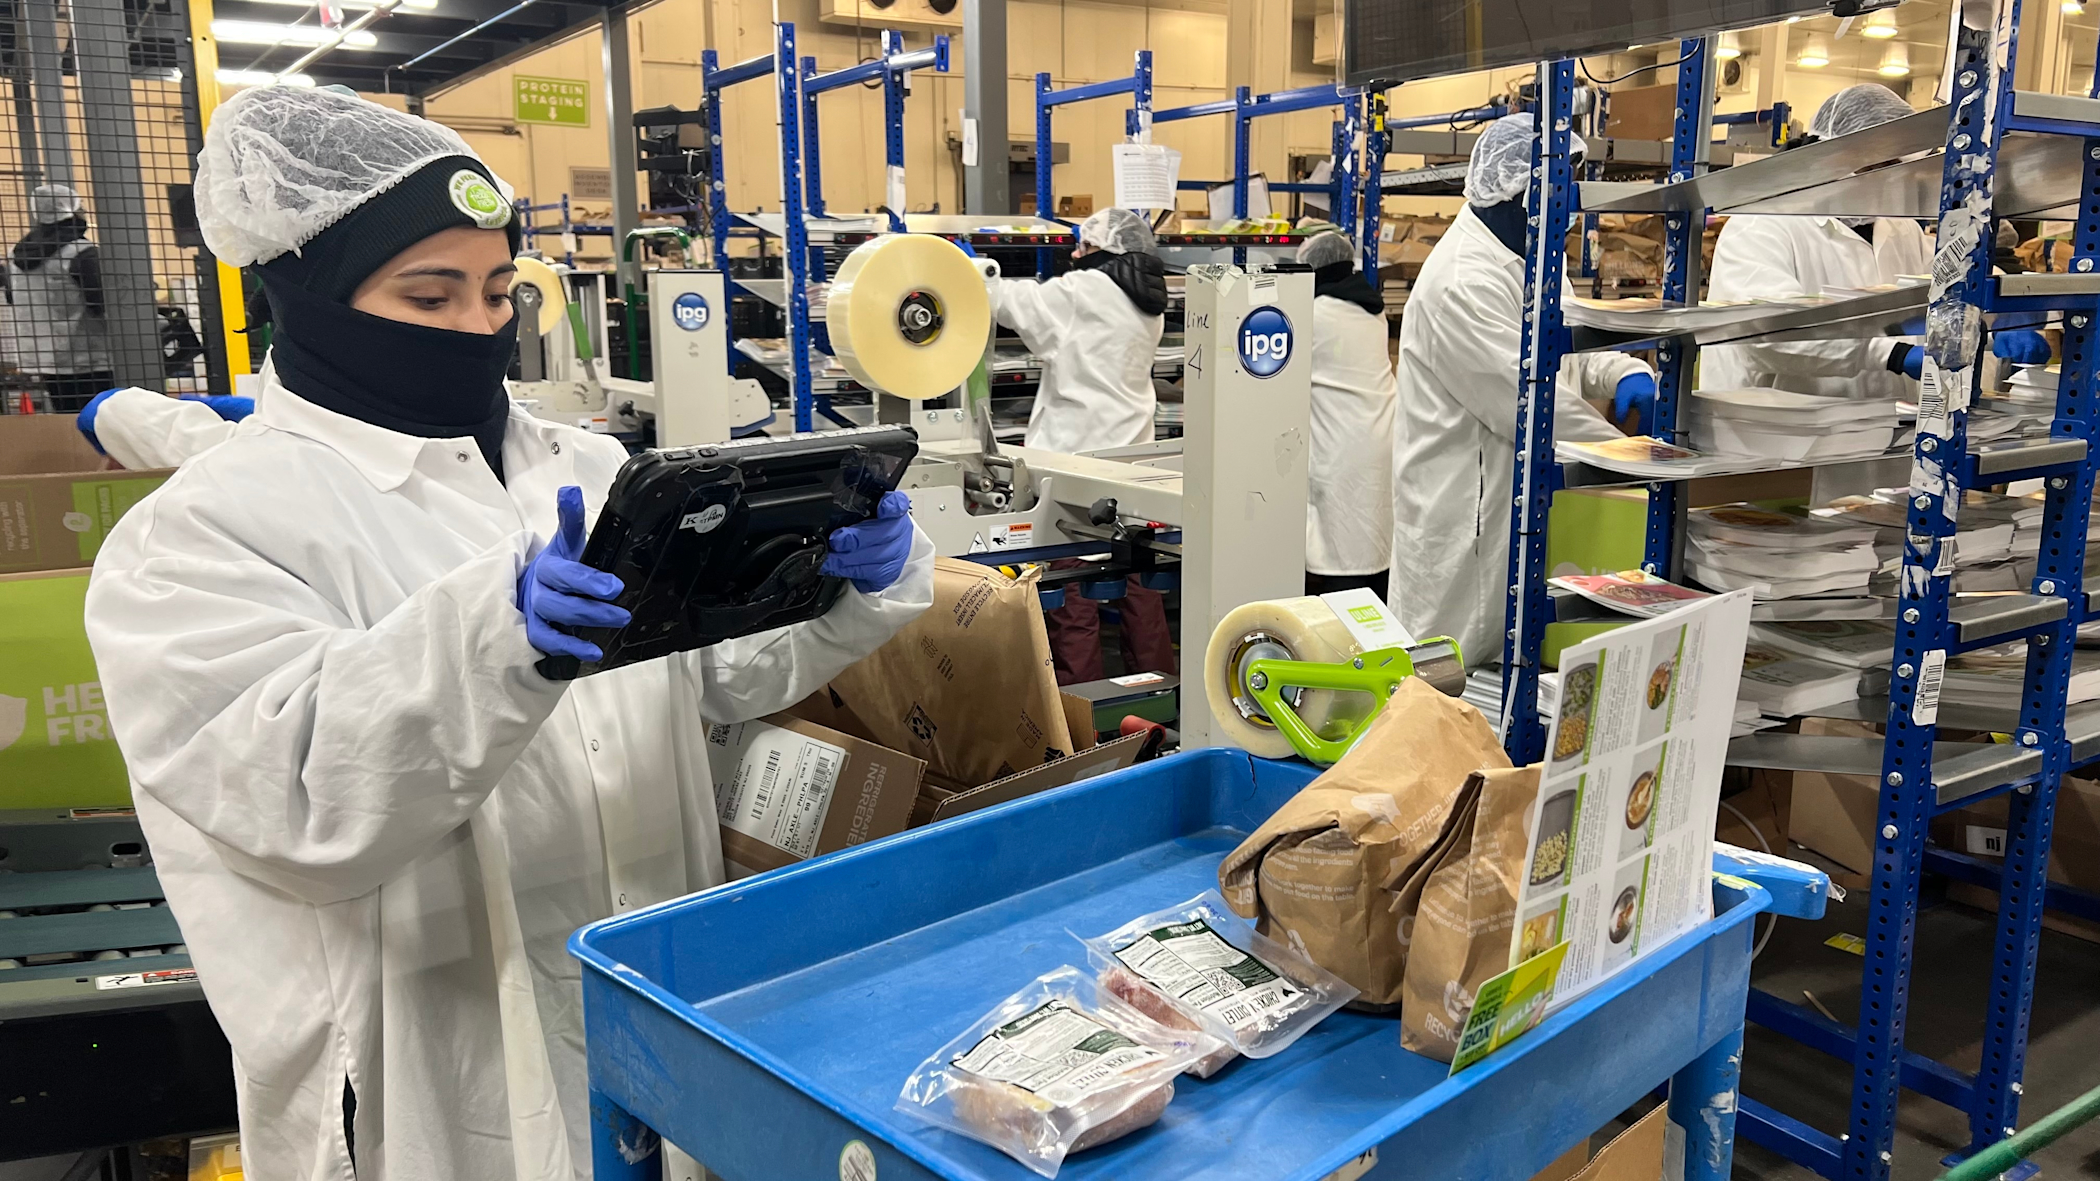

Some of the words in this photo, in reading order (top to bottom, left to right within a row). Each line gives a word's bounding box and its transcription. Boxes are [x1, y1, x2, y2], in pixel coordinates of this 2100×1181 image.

[520, 81, 583, 95] PROTEIN
[520, 94, 584, 108] STAGING
[676, 303, 707, 323] ipg
[1244, 329, 1288, 362] ipg
[1188, 344, 1202, 379] 4
[974, 586, 994, 611] RECYCLE
[1350, 606, 1381, 621] ULINE
[42, 681, 106, 715] HE
[1313, 856, 1354, 866] ingredients
[1221, 1003, 1251, 1026] CUTLET
[1468, 1000, 1502, 1032] FREE
[1500, 990, 1544, 1038] HELLO
[1462, 1021, 1494, 1051] BOX
